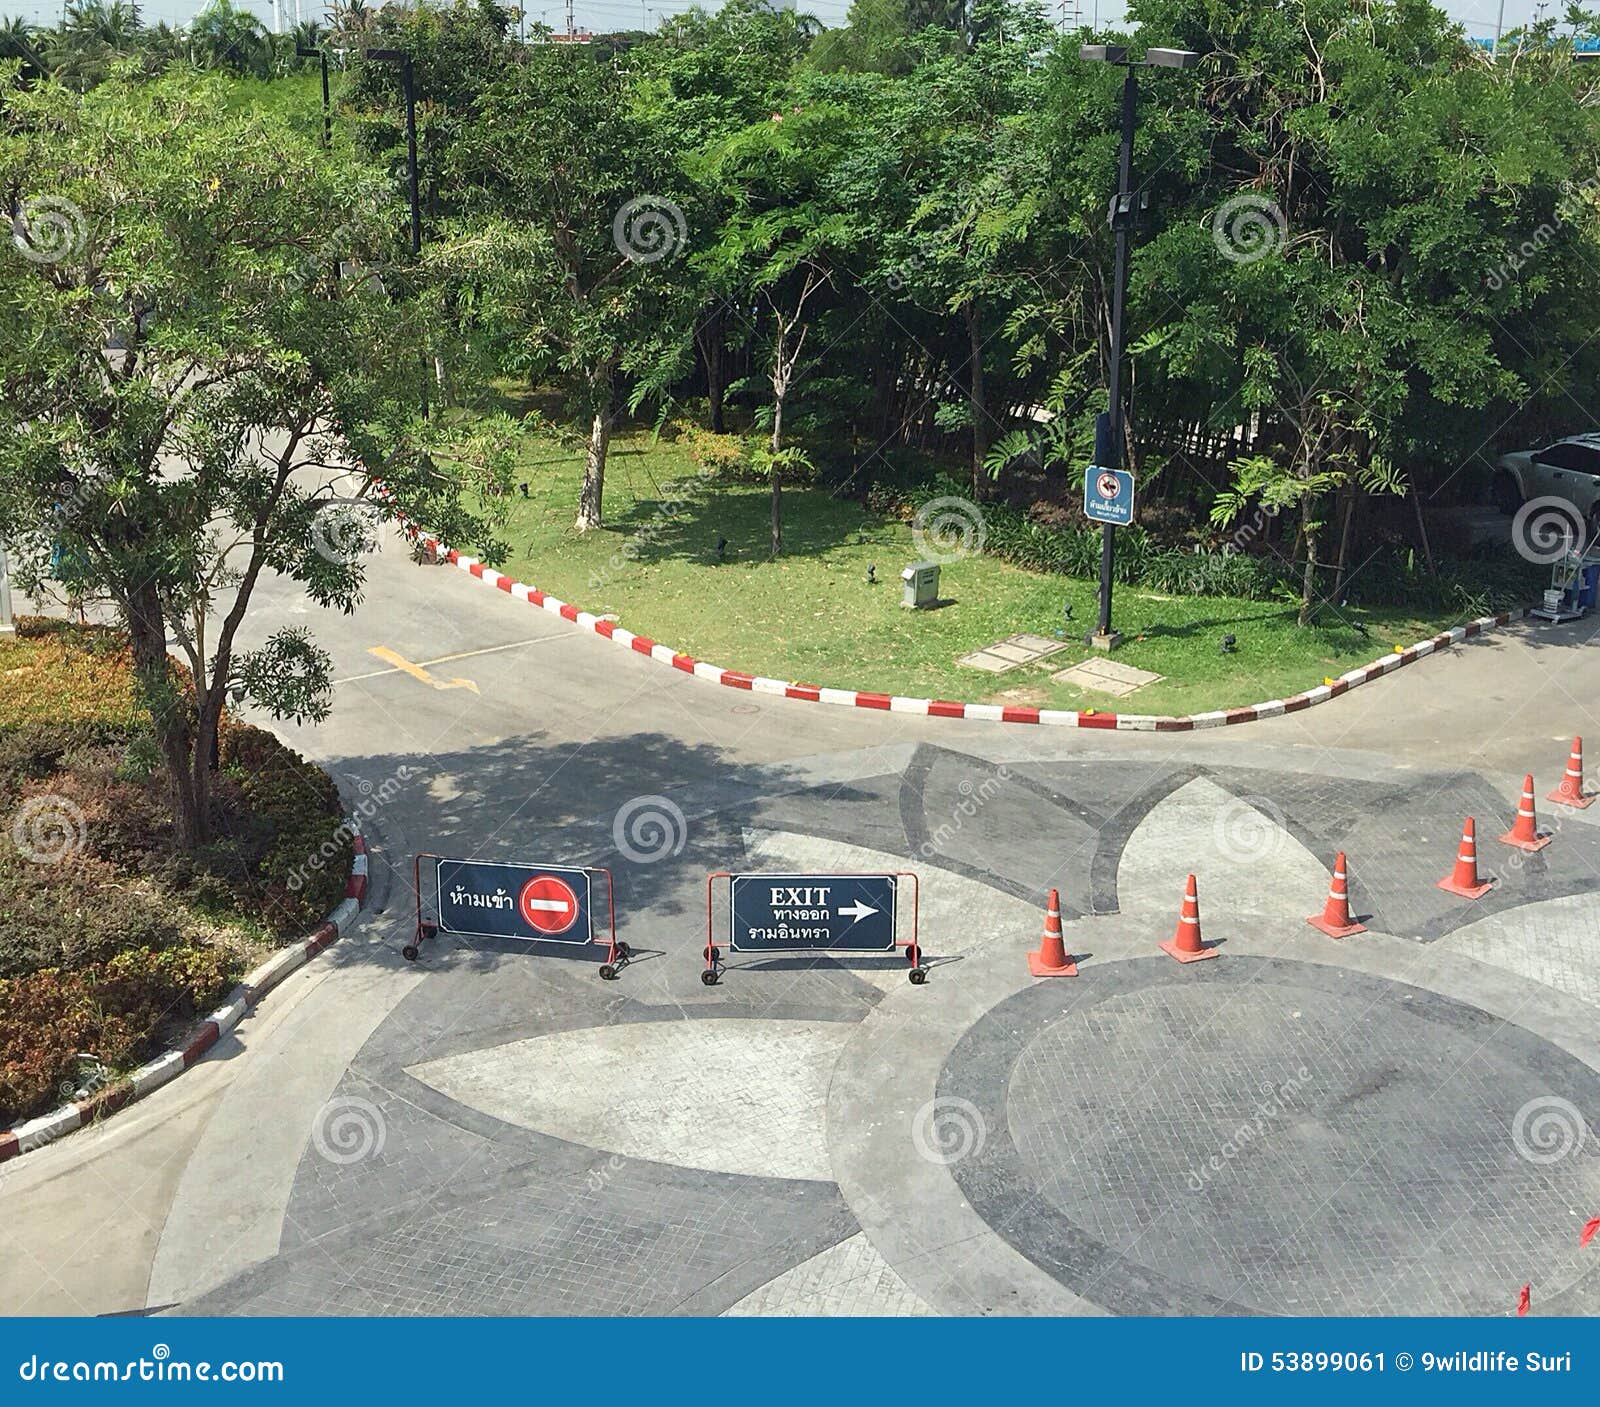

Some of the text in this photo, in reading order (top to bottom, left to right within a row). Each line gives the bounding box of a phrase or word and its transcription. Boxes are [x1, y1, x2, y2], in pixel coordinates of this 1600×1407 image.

[450, 885, 514, 910] ห้ามเข้า
[769, 887, 831, 906] EXIT
[773, 908, 830, 921] ทางออก
[749, 923, 830, 939] รามอินทรา
